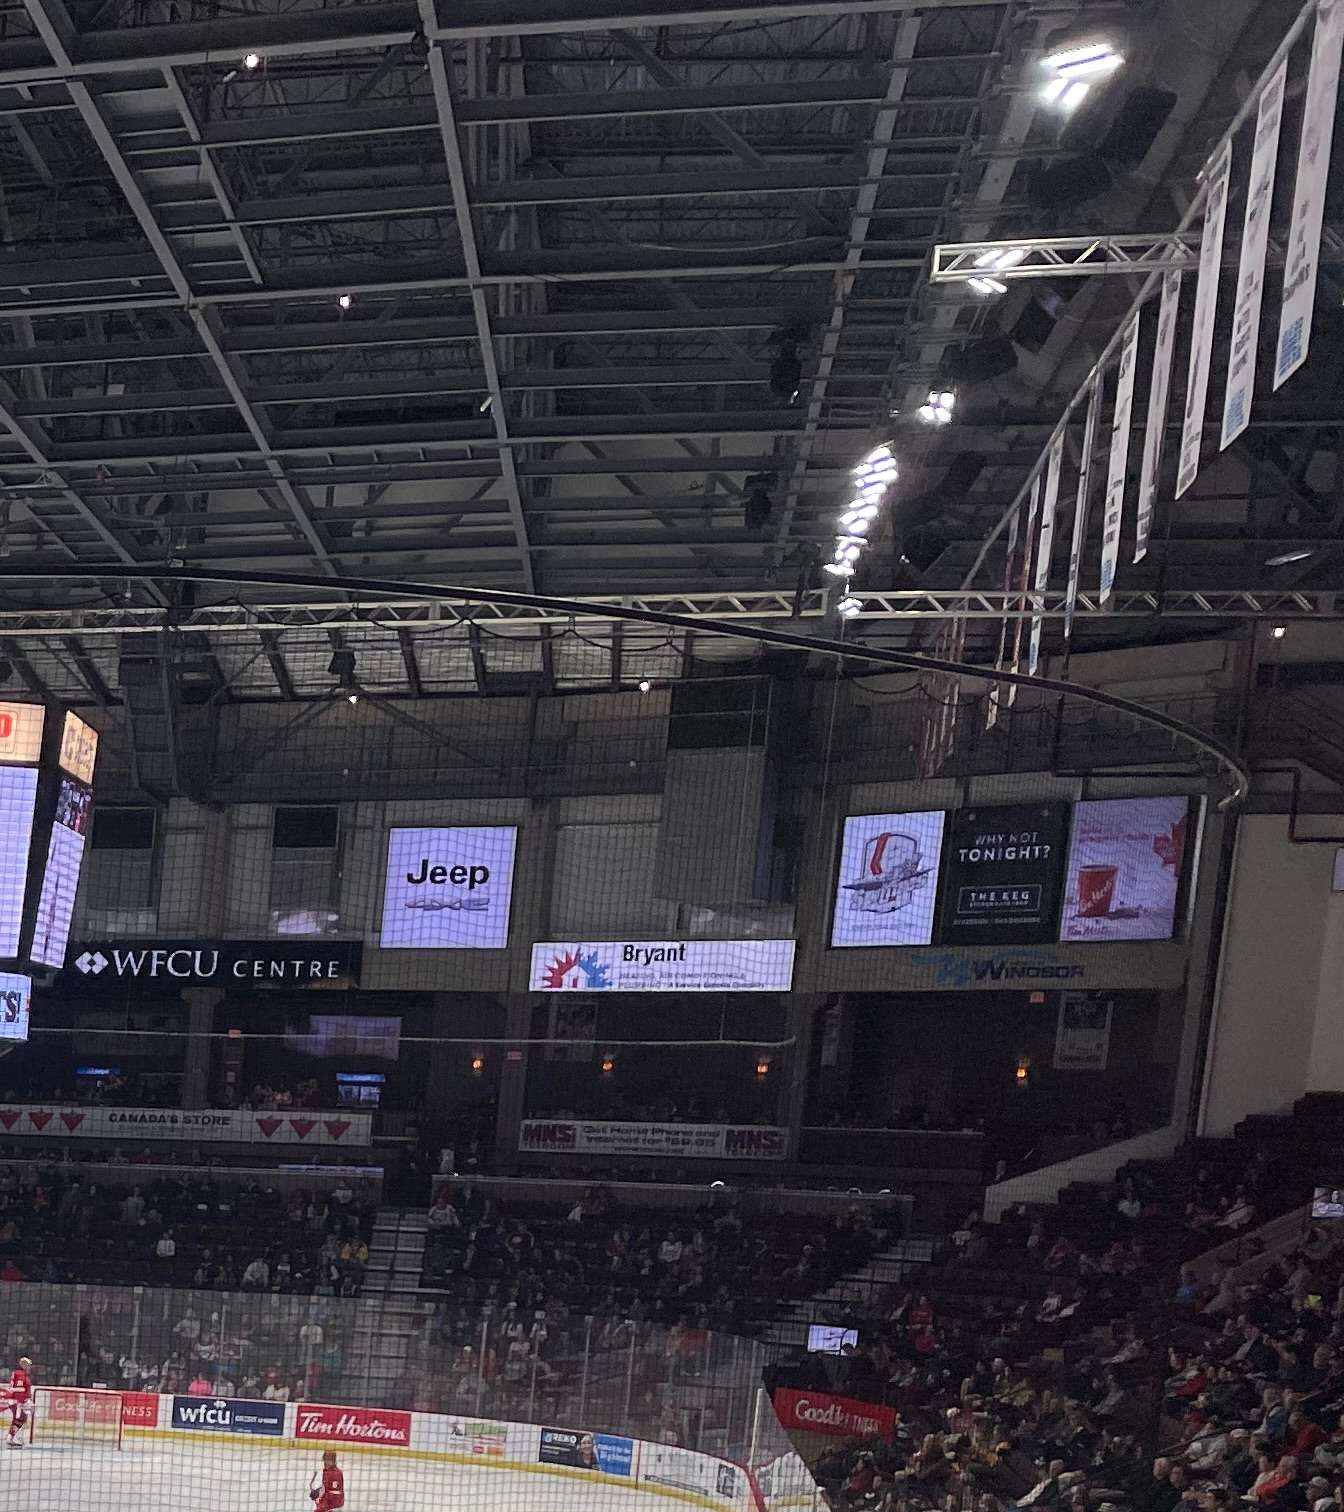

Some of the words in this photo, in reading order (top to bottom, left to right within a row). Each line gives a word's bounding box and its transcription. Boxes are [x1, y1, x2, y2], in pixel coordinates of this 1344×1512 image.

[975, 833, 1004, 847] WHY
[959, 846, 1051, 863] TONIGHT?
[406, 858, 491, 890] Jeep
[112, 950, 219, 977] WFCU
[233, 959, 341, 978] CENTRE
[623, 943, 687, 966] Bryant
[182, 1114, 232, 1127] STORE
[179, 1399, 232, 1426] wfcu
[300, 1411, 333, 1435] Tim
[336, 1412, 407, 1441] Hortons
